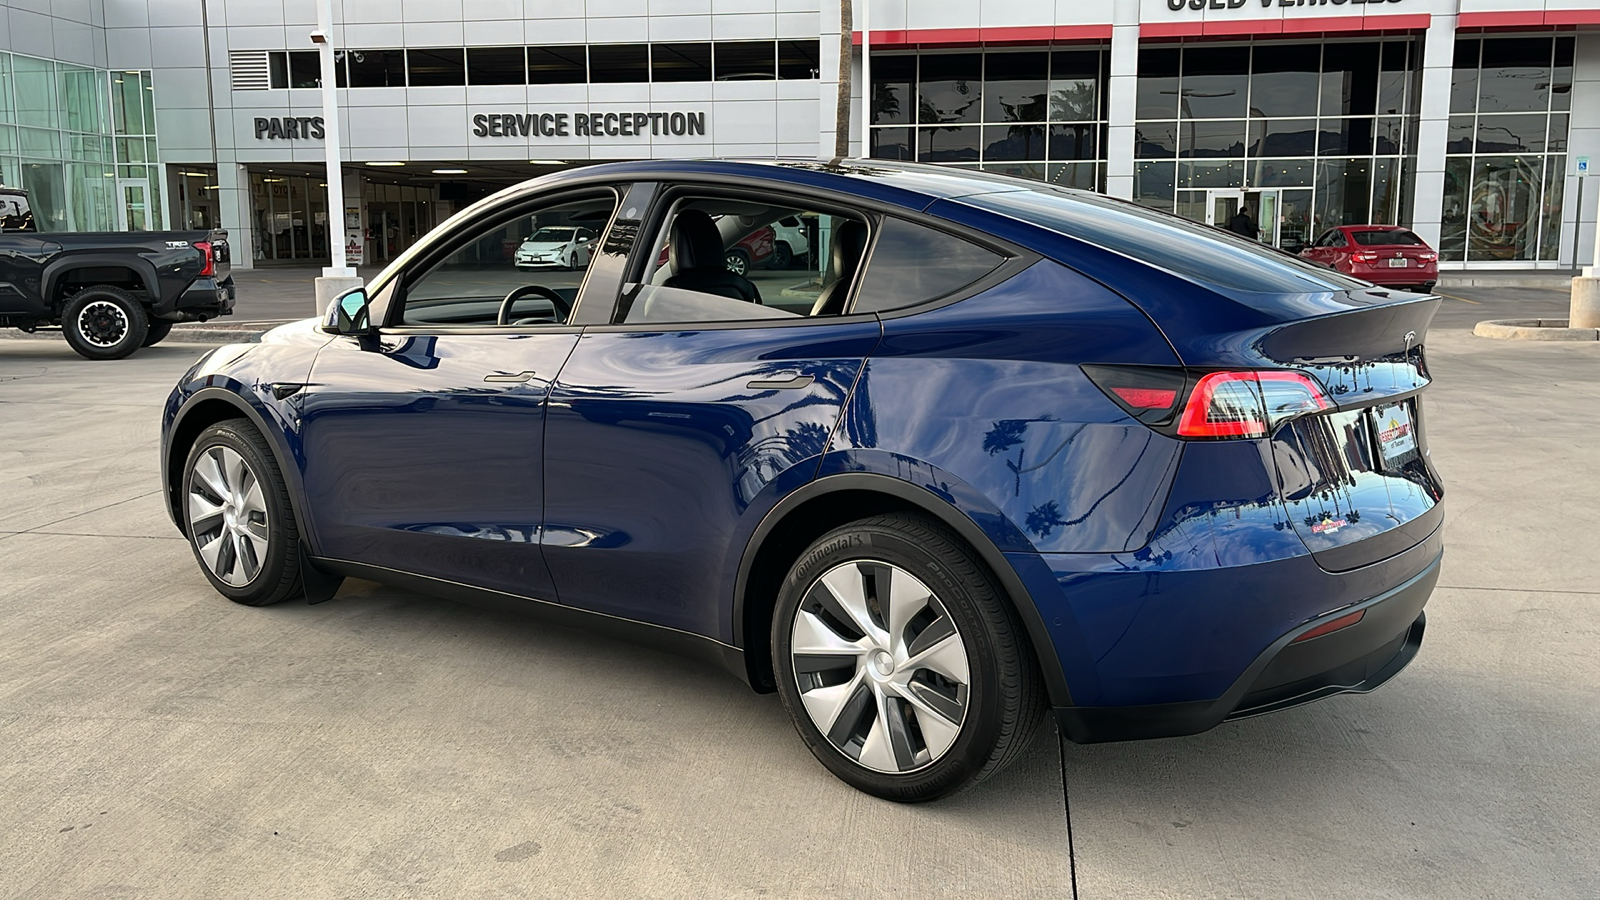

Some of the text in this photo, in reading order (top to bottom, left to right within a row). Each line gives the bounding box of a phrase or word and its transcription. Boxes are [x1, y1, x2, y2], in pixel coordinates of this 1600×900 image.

[254, 117, 325, 139] PARTS
[473, 112, 705, 137] SERVICE RECEPTION
[796, 536, 852, 581] Continental
